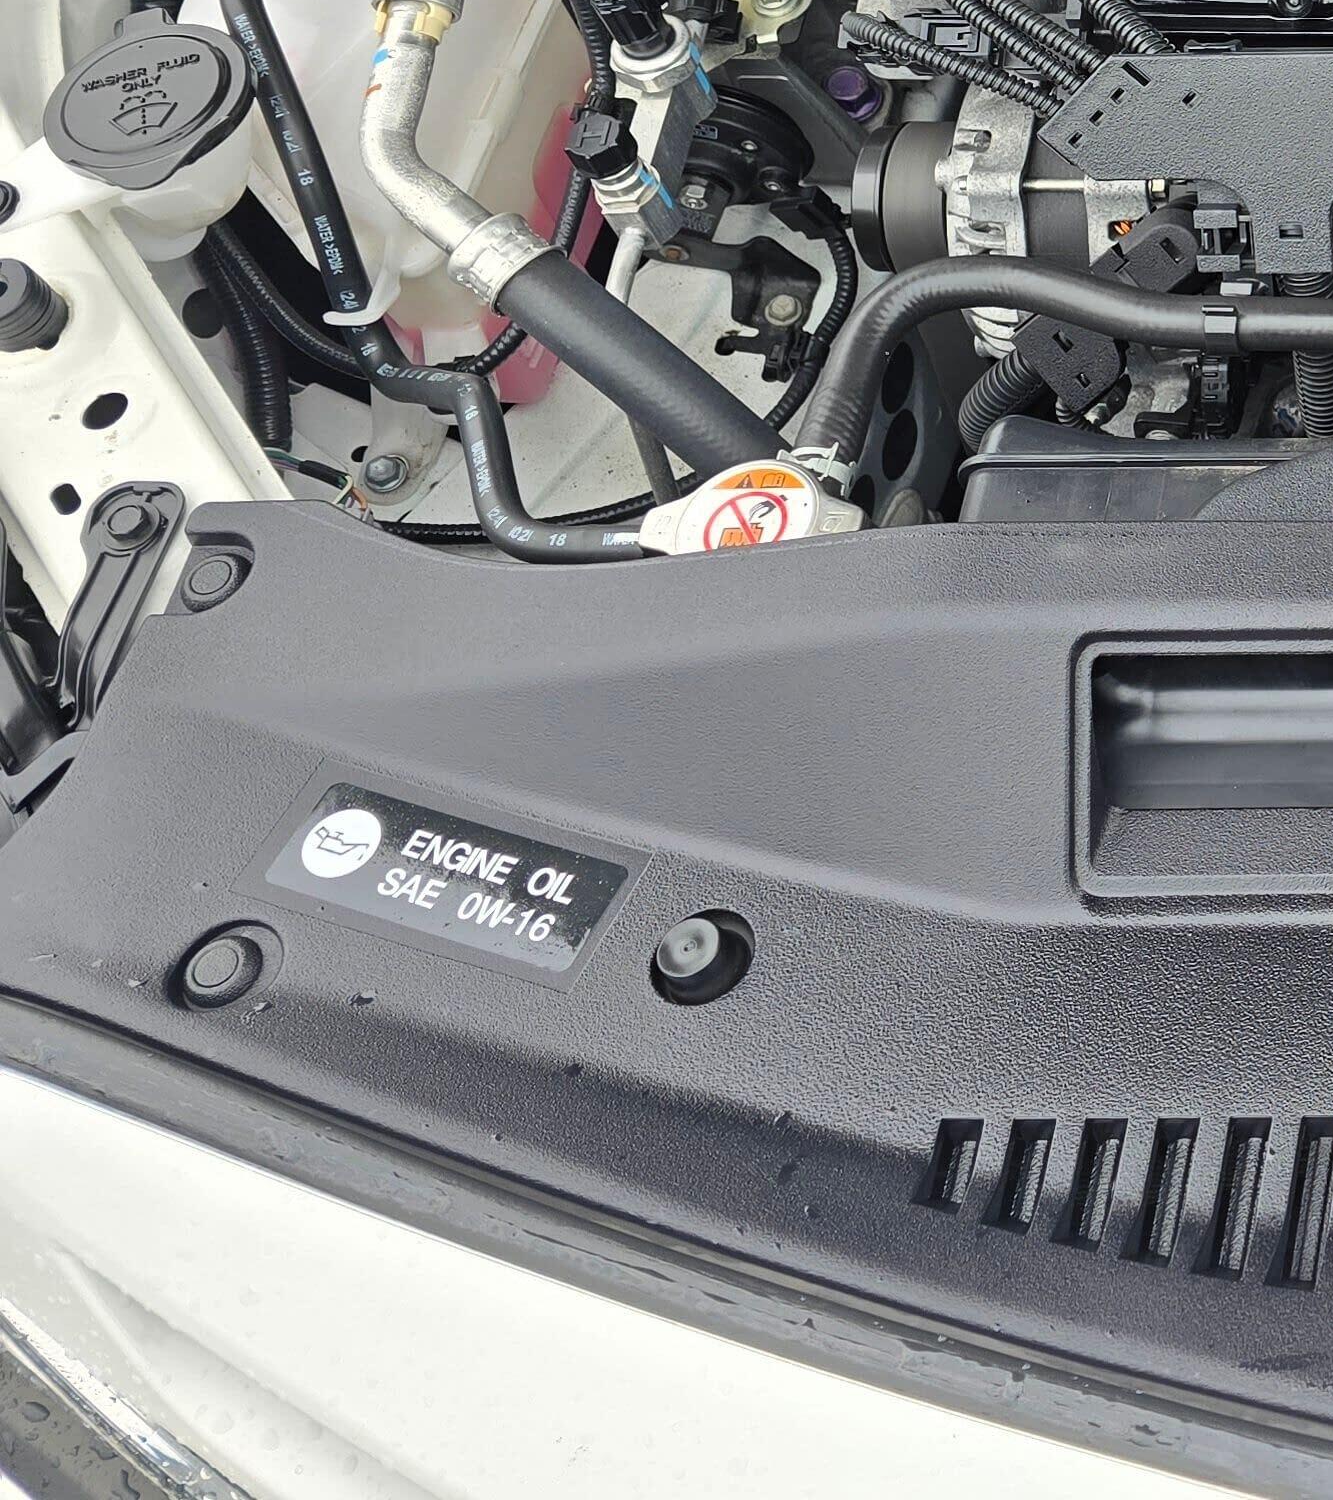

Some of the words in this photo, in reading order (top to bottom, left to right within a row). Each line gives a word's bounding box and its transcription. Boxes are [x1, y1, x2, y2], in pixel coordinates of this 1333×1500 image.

[82, 67, 147, 93] WASHER
[157, 53, 200, 73] FLUID
[122, 75, 161, 93] ONLY
[234, 13, 257, 45] WATER
[297, 166, 316, 188] 18
[313, 213, 336, 244] WATER
[547, 531, 567, 548] 18
[400, 830, 518, 886] ENGINE
[527, 866, 576, 905] OIL
[377, 868, 447, 910] SAE
[456, 890, 557, 943] 0W-16
